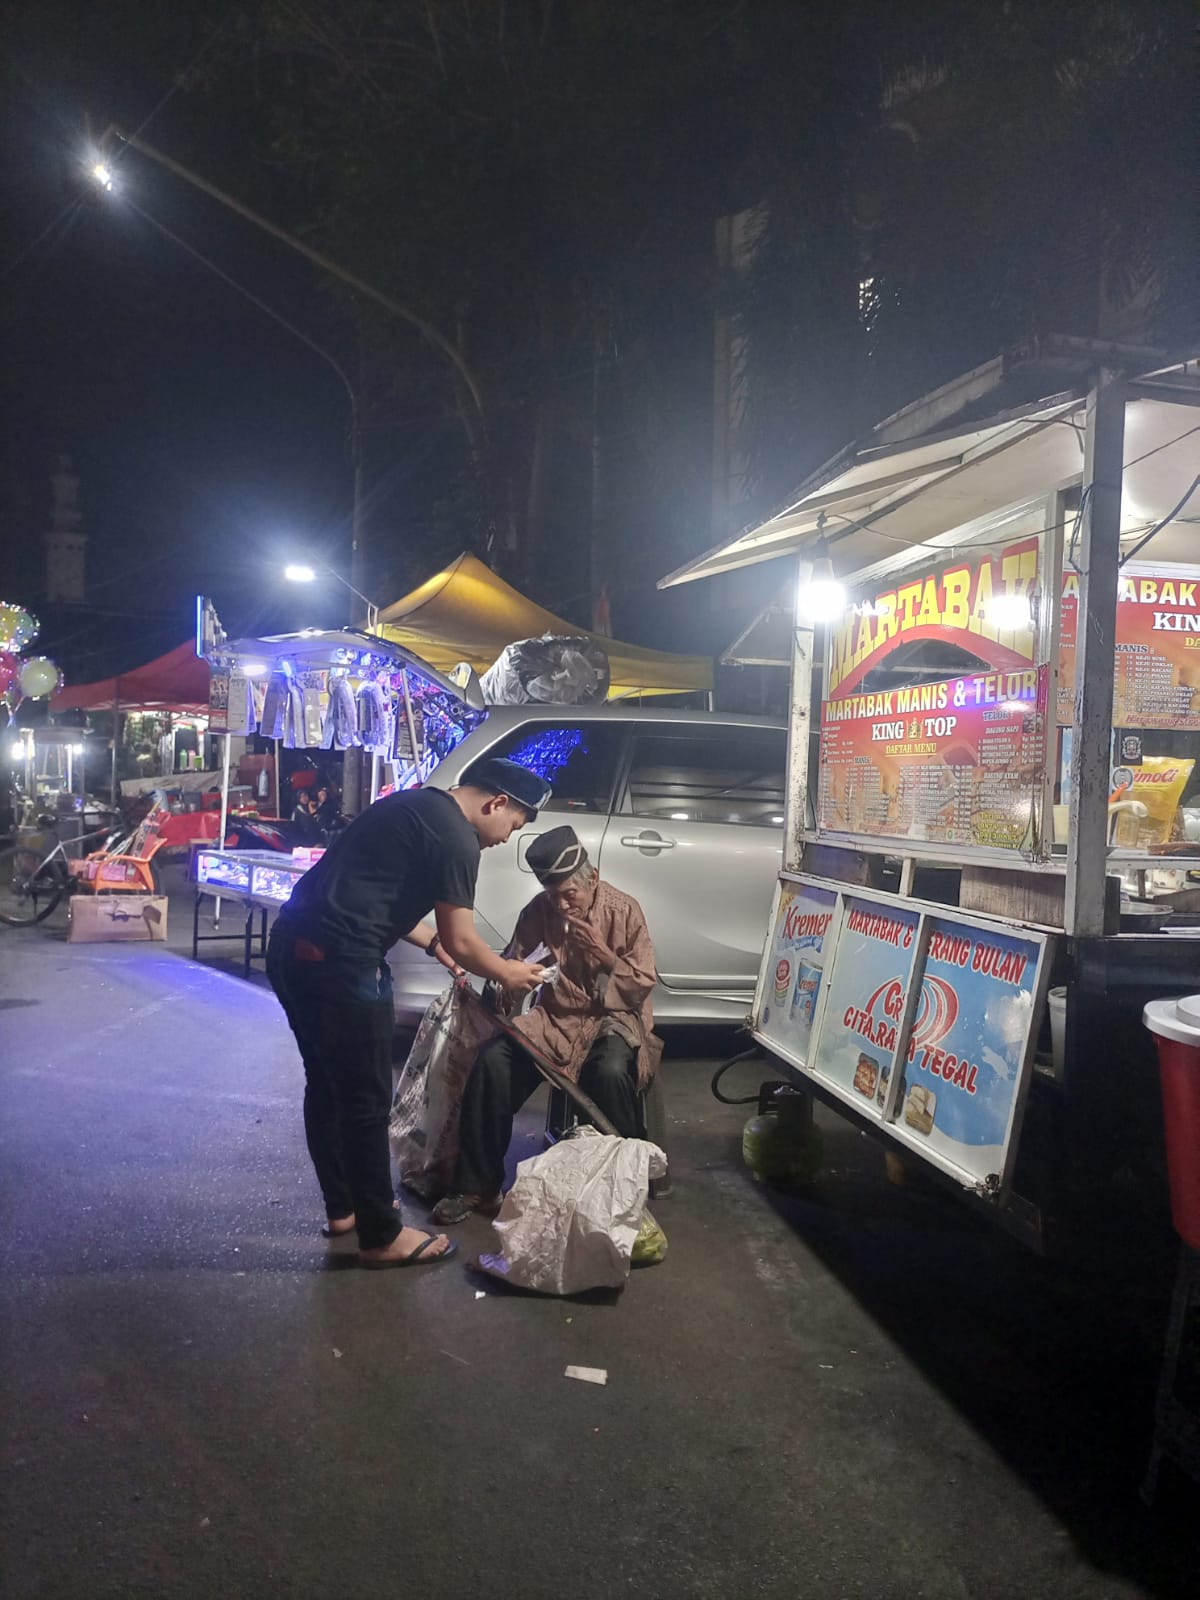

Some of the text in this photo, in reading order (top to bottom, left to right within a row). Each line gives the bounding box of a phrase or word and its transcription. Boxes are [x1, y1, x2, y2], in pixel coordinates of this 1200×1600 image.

[829, 550, 1038, 694] MARTABAK
[826, 692, 892, 722] MARTABAK
[897, 683, 947, 714] MANIS
[953, 680, 967, 706] &
[973, 670, 1037, 704] TELOR
[872, 717, 957, 741] KING TOP
[886, 743, 936, 754] DAFTAR MENU
[782, 906, 832, 940] Kremer
[848, 911, 903, 948] MARTABAK
[903, 924, 914, 949] &
[972, 942, 1027, 985] BULAN
[920, 1045, 978, 1094] TEGAL
